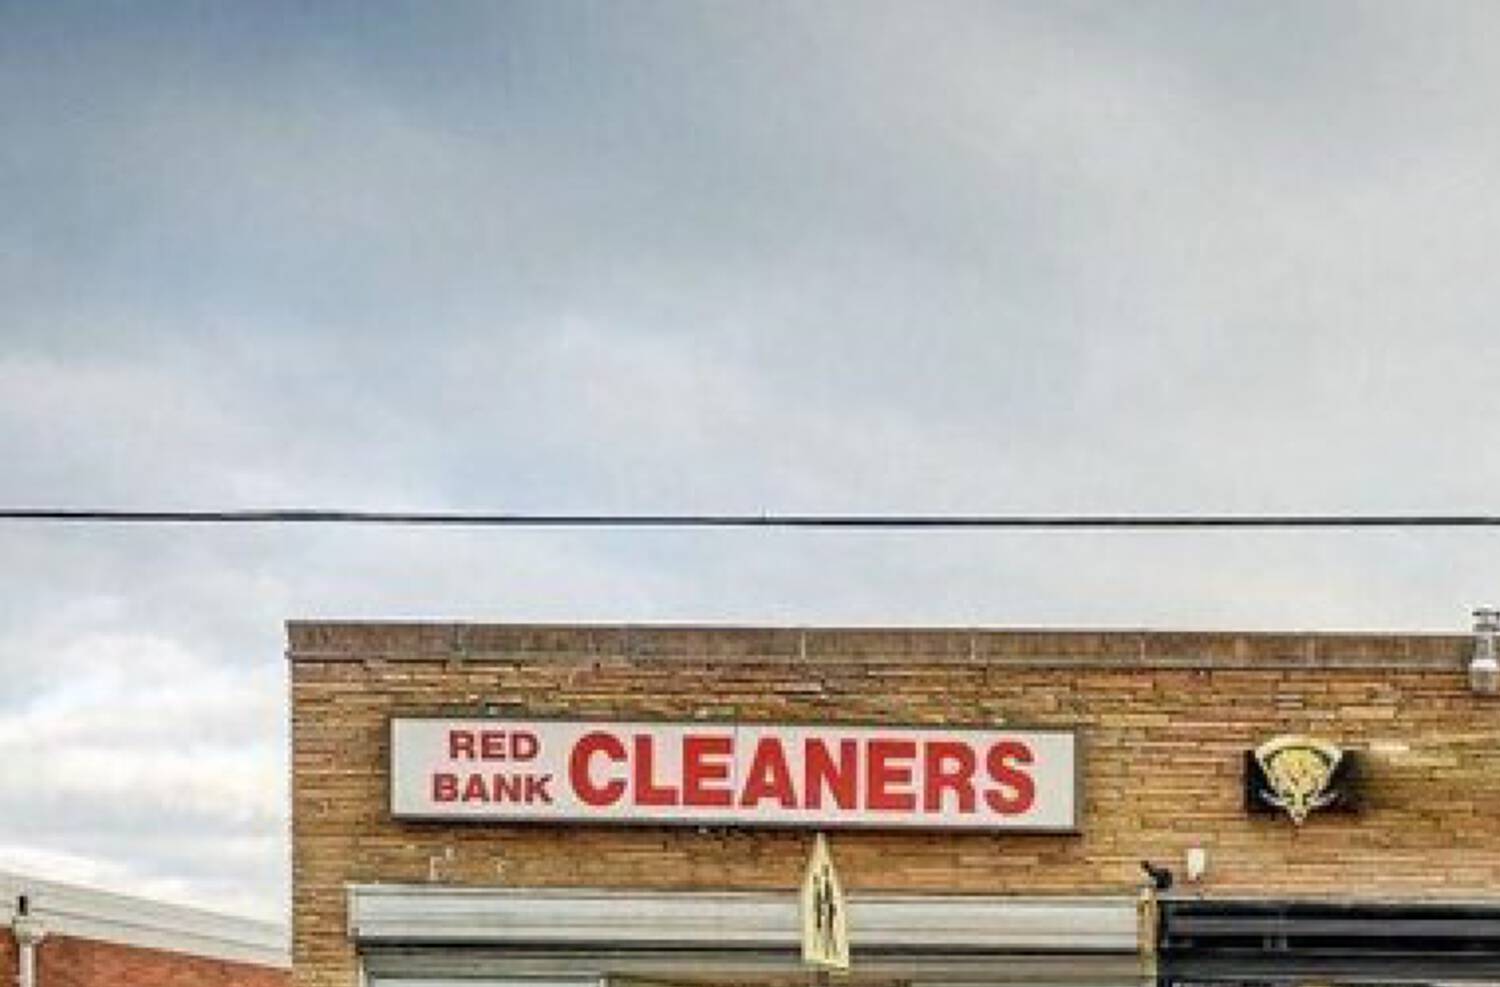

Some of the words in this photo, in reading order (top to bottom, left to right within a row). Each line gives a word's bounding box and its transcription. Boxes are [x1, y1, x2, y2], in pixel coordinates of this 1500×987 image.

[448, 730, 539, 761] RED
[431, 773, 552, 804] BANK
[567, 732, 1038, 814] CLEANERS
